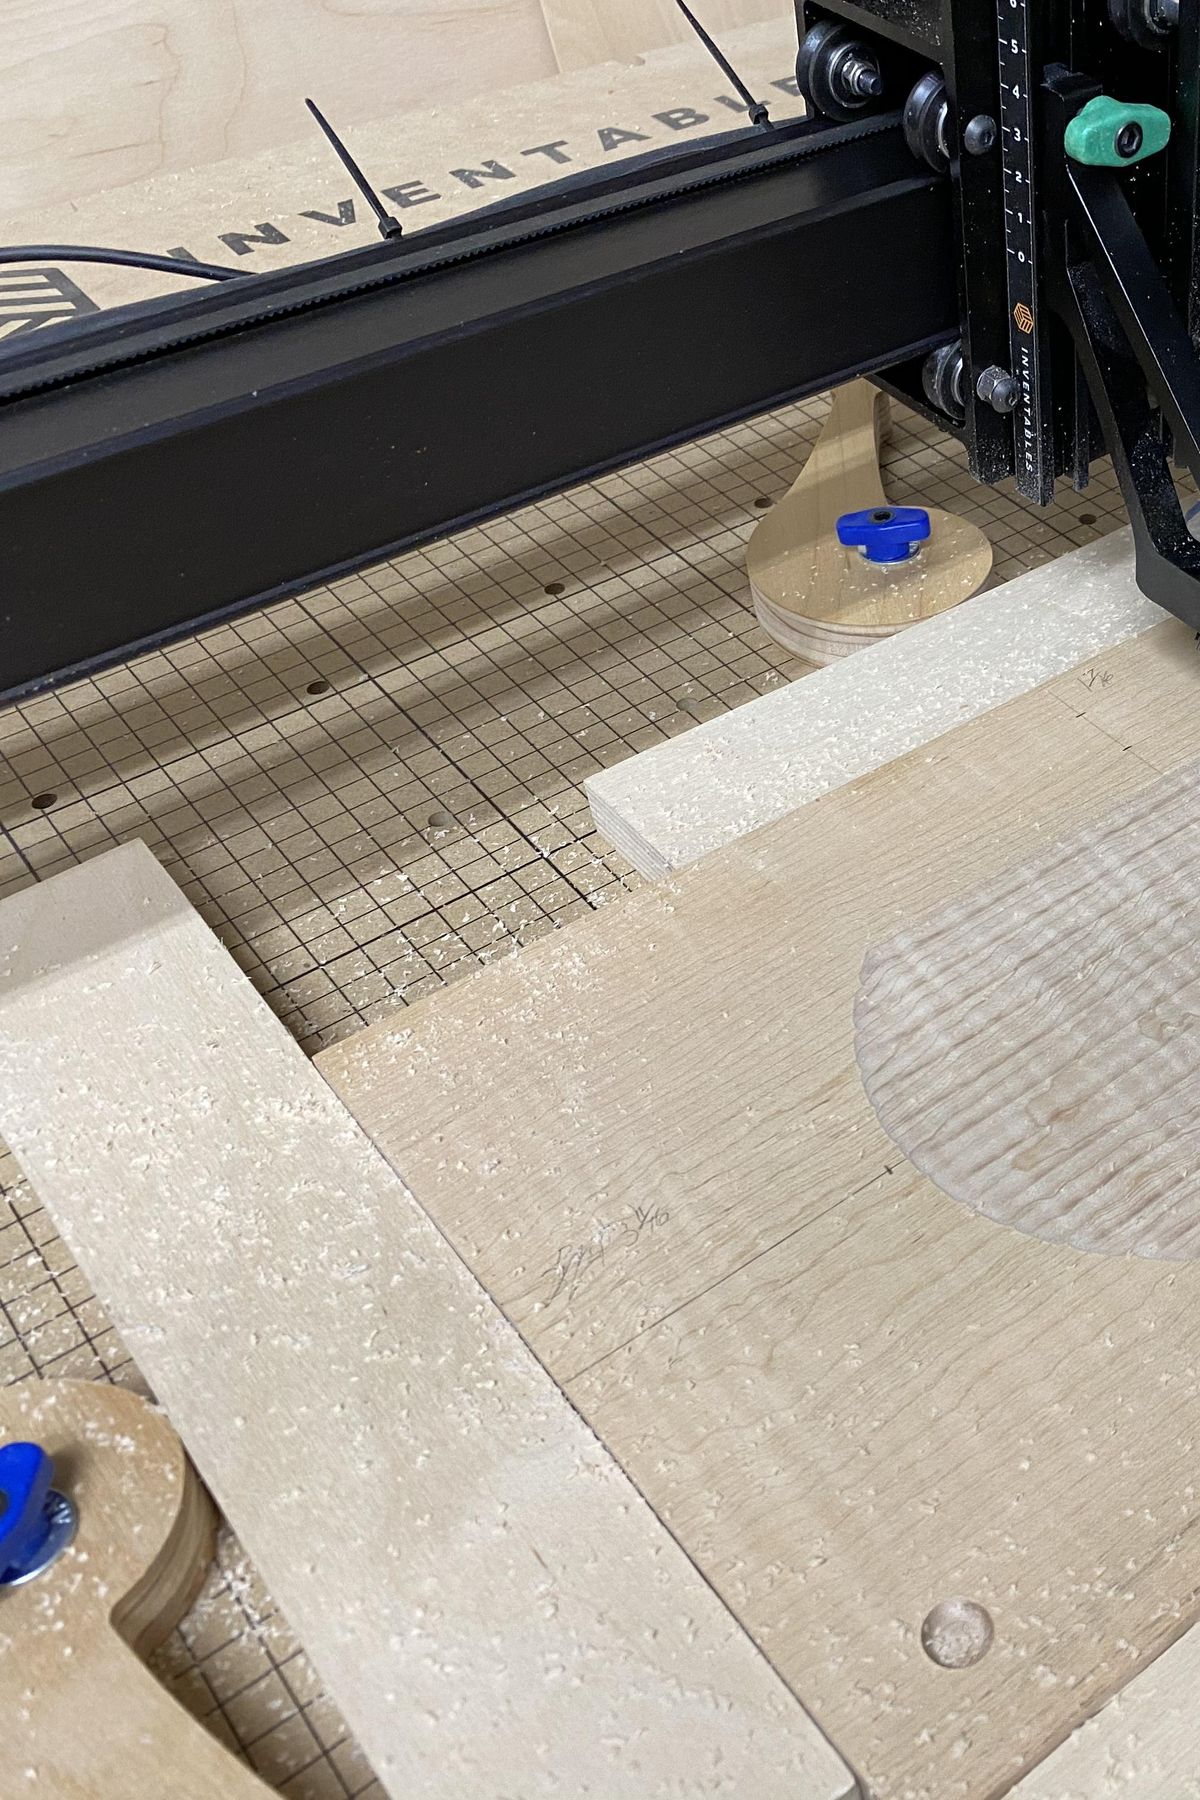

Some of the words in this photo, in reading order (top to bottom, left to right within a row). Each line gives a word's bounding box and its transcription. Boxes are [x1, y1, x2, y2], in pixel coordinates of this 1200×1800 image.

[1011, 38, 1019, 54] 5
[1012, 84, 1021, 100] 4
[1014, 127, 1022, 142] 3
[1015, 170, 1023, 184] 2
[1017, 212, 1023, 224] 1
[1018, 251, 1025, 263] 0
[1021, 347, 1033, 472] INVENTABLES
